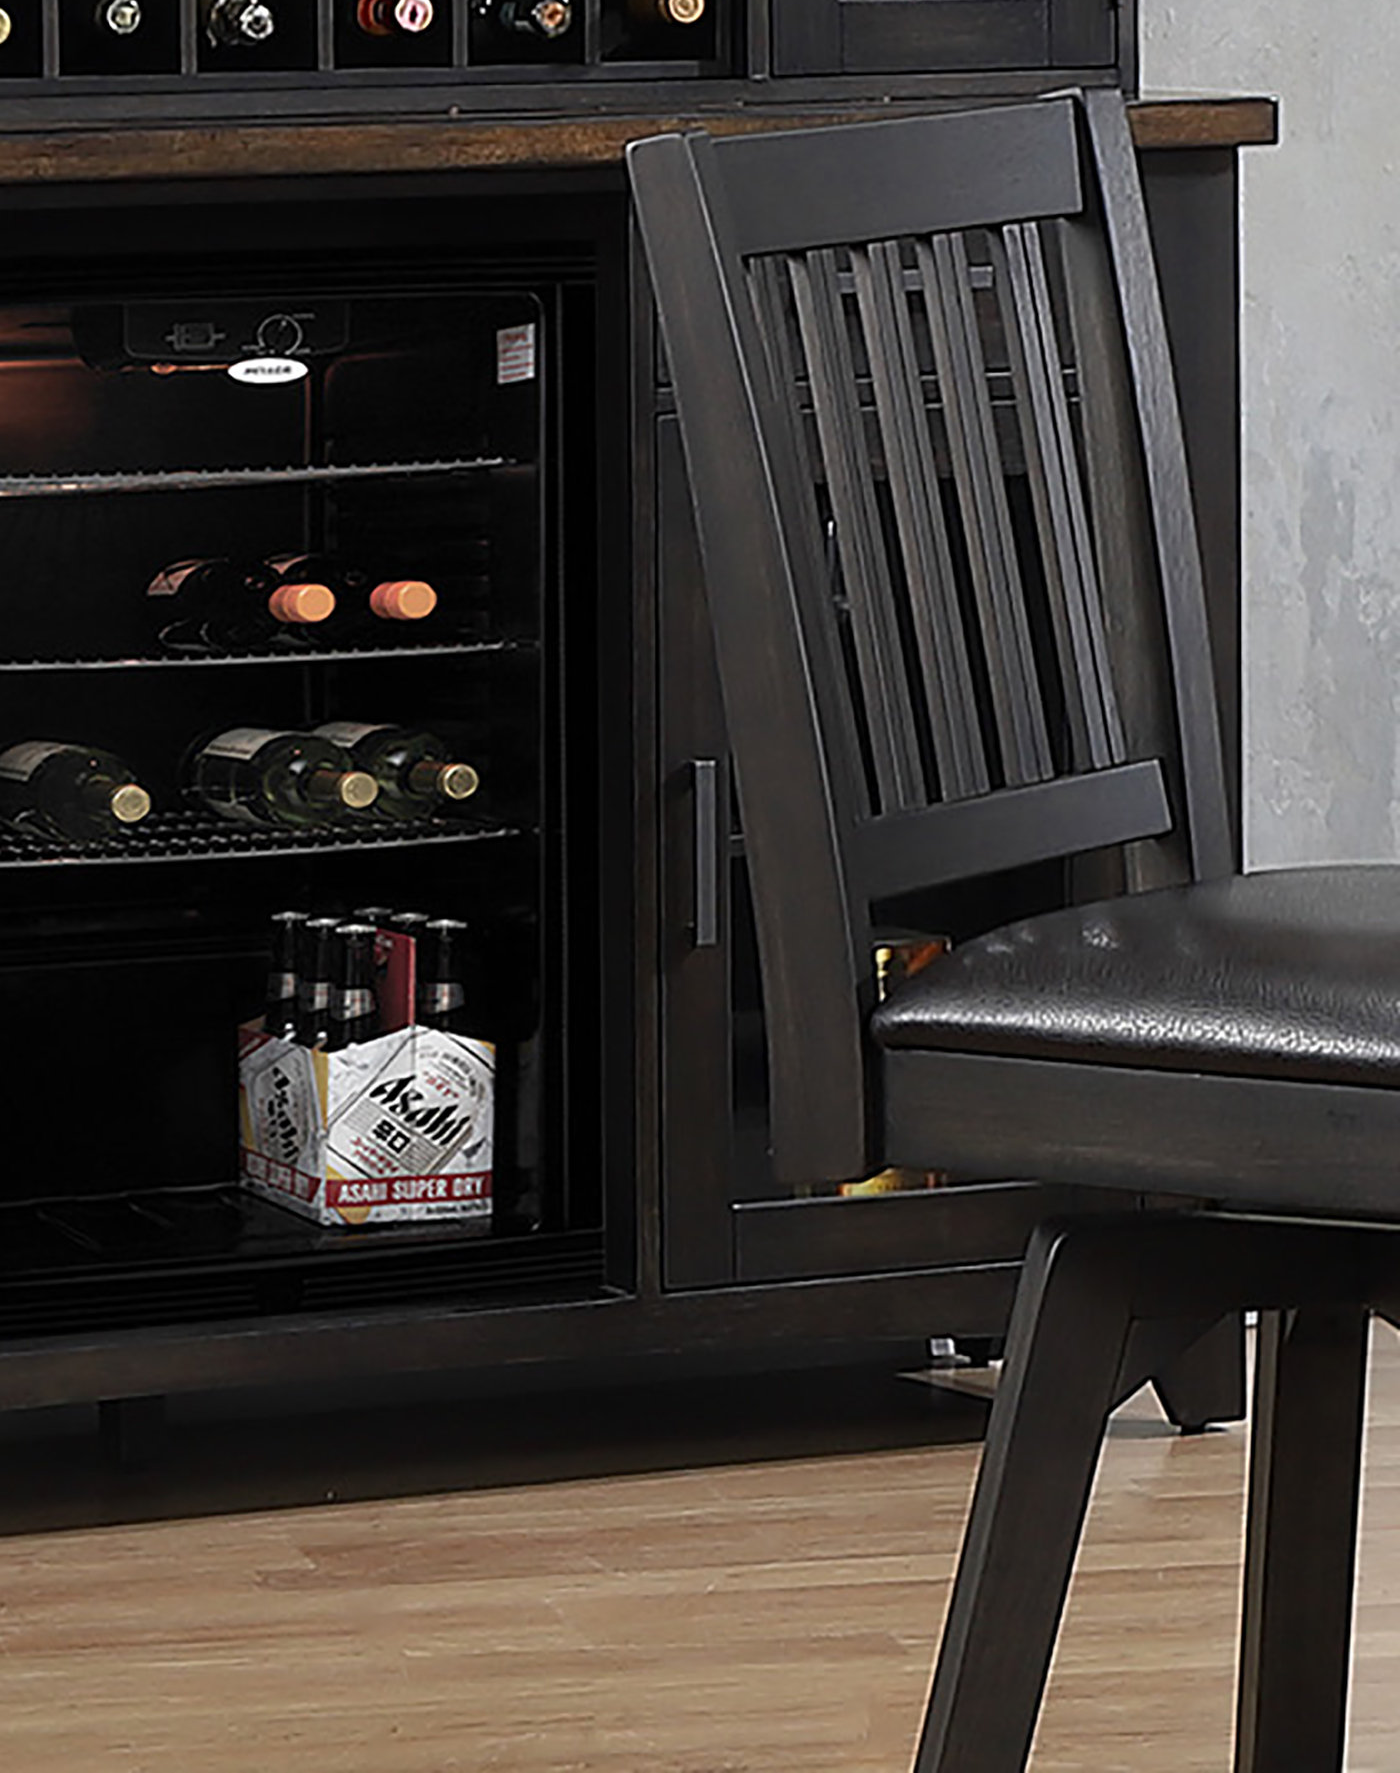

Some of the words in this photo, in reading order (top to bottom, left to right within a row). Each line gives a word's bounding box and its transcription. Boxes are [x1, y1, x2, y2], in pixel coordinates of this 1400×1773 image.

[369, 1074, 471, 1146] Asahi
[338, 1183, 388, 1203] ASAHI
[391, 1179, 448, 1200] SUPER
[452, 1176, 485, 1197] DRY
